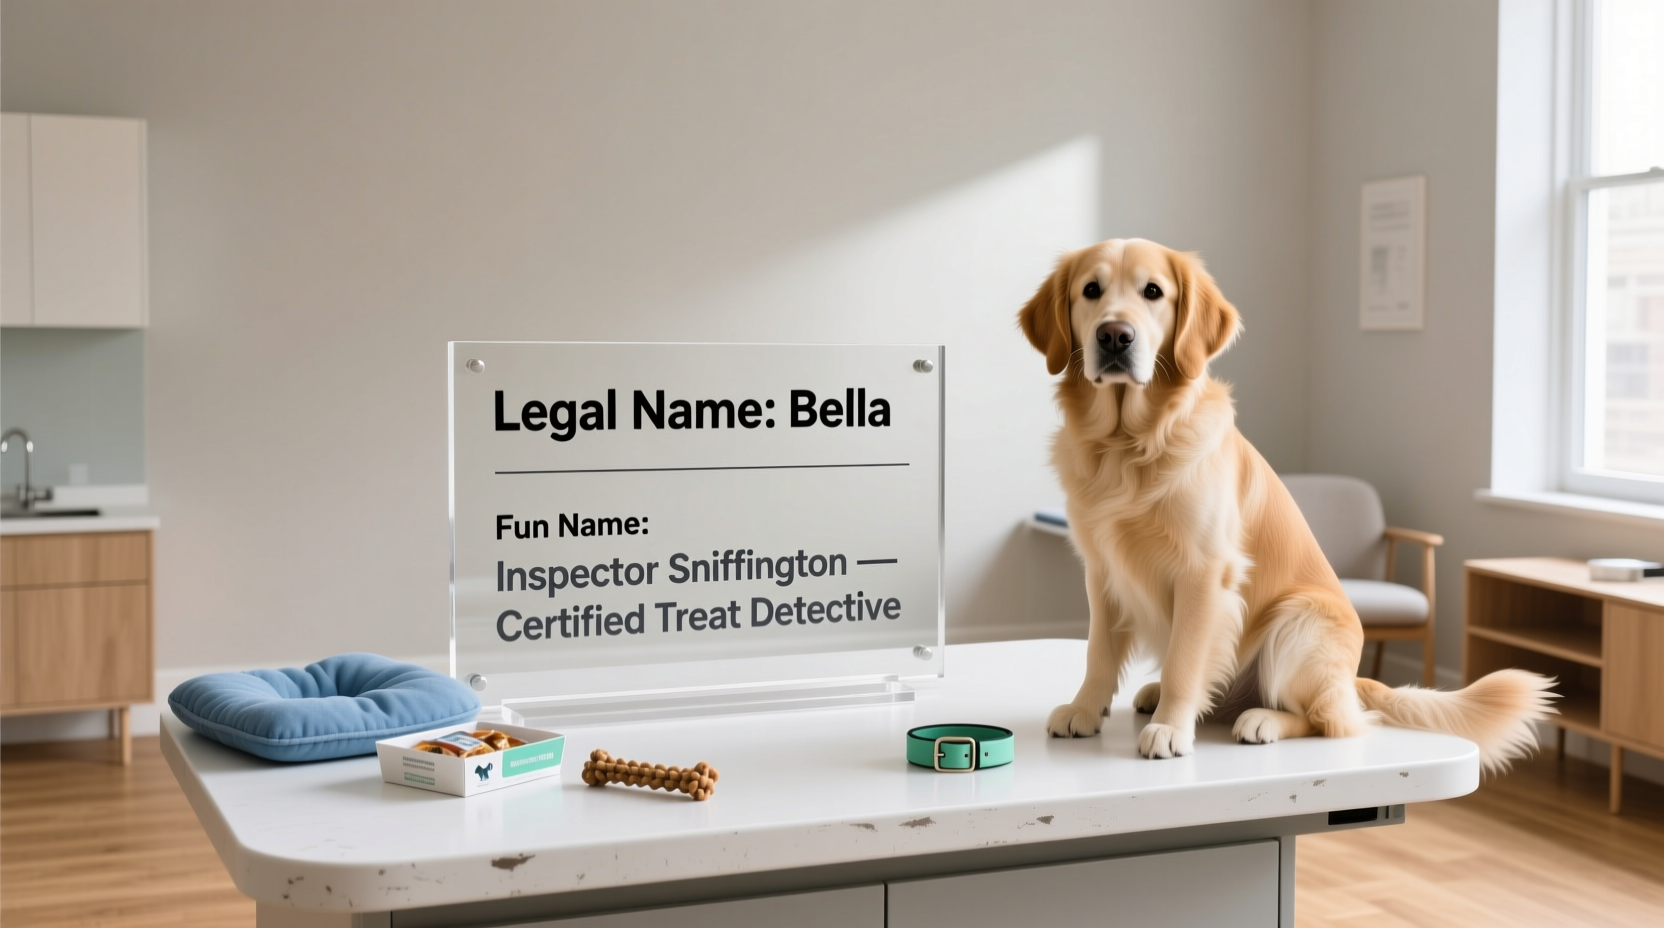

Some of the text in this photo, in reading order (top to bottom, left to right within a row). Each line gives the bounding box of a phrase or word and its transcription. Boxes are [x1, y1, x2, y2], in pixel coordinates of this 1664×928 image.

[494, 387, 891, 443] Legal Name: Bella
[496, 512, 649, 541] Fun Name:
[497, 548, 898, 599] Inspector Sniffington —
[496, 590, 902, 643] Certified Treat Detective
